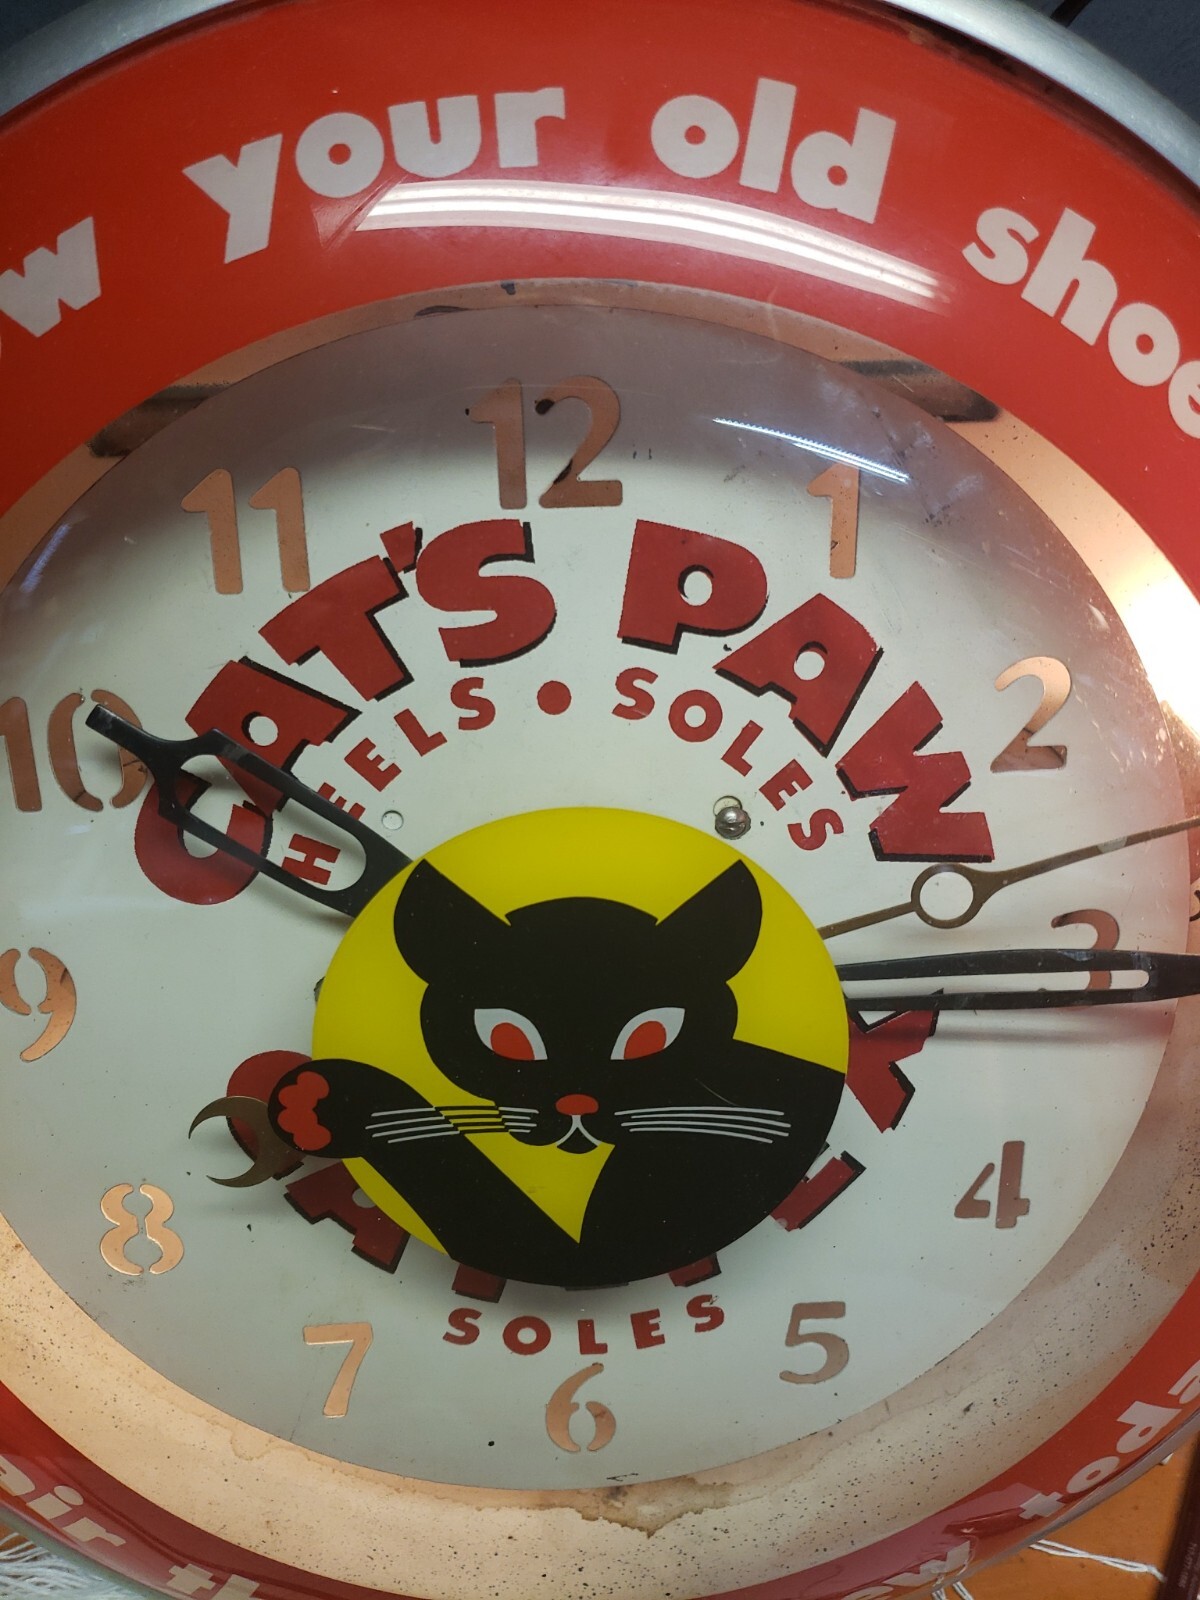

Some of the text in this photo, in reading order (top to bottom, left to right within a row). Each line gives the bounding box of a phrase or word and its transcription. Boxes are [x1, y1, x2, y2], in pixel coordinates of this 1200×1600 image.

[182, 87, 566, 264] your
[650, 77, 897, 224] old
[467, 375, 623, 510] 12
[181, 468, 310, 595] 11
[807, 463, 860, 579] 1
[0, 689, 149, 812] 10
[134, 519, 995, 905] CAT'S PAW
[611, 667, 844, 851] SOLES
[989, 656, 1072, 773] 2
[0, 947, 77, 1062] 9
[100, 1183, 184, 1275] 8
[954, 1140, 1030, 1229] 4
[303, 1322, 374, 1418] 7
[442, 1294, 725, 1356] SOLES
[779, 1301, 850, 1385] 5
[545, 1362, 617, 1453] 6
